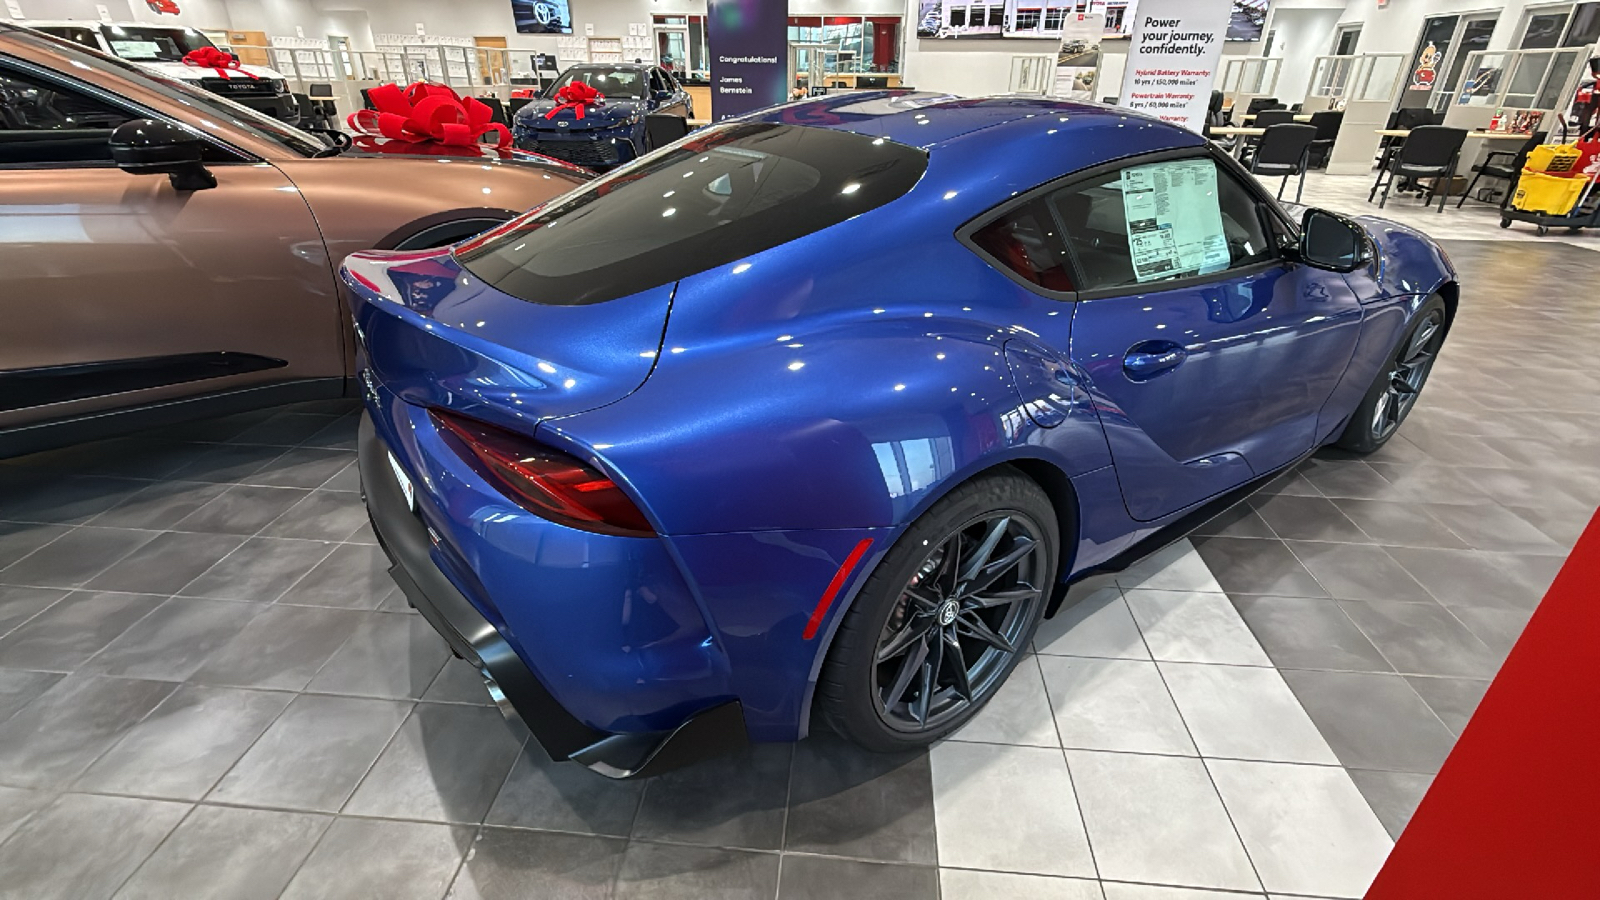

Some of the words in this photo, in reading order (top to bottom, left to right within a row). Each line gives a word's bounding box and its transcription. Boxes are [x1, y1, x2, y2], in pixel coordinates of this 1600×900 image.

[1144, 16, 1181, 27] Power
[1141, 32, 1168, 44] your
[1168, 29, 1214, 44] journey,
[1139, 42, 1206, 57] confidently.
[719, 56, 777, 64] Congratulations!
[1135, 69, 1157, 77] Hybrid
[1157, 69, 1180, 77] Battery
[1180, 69, 1211, 78] Warranty:
[720, 86, 752, 94] Bernstein
[1131, 92, 1164, 100] Powertrain
[1165, 92, 1195, 100] Warranty:
